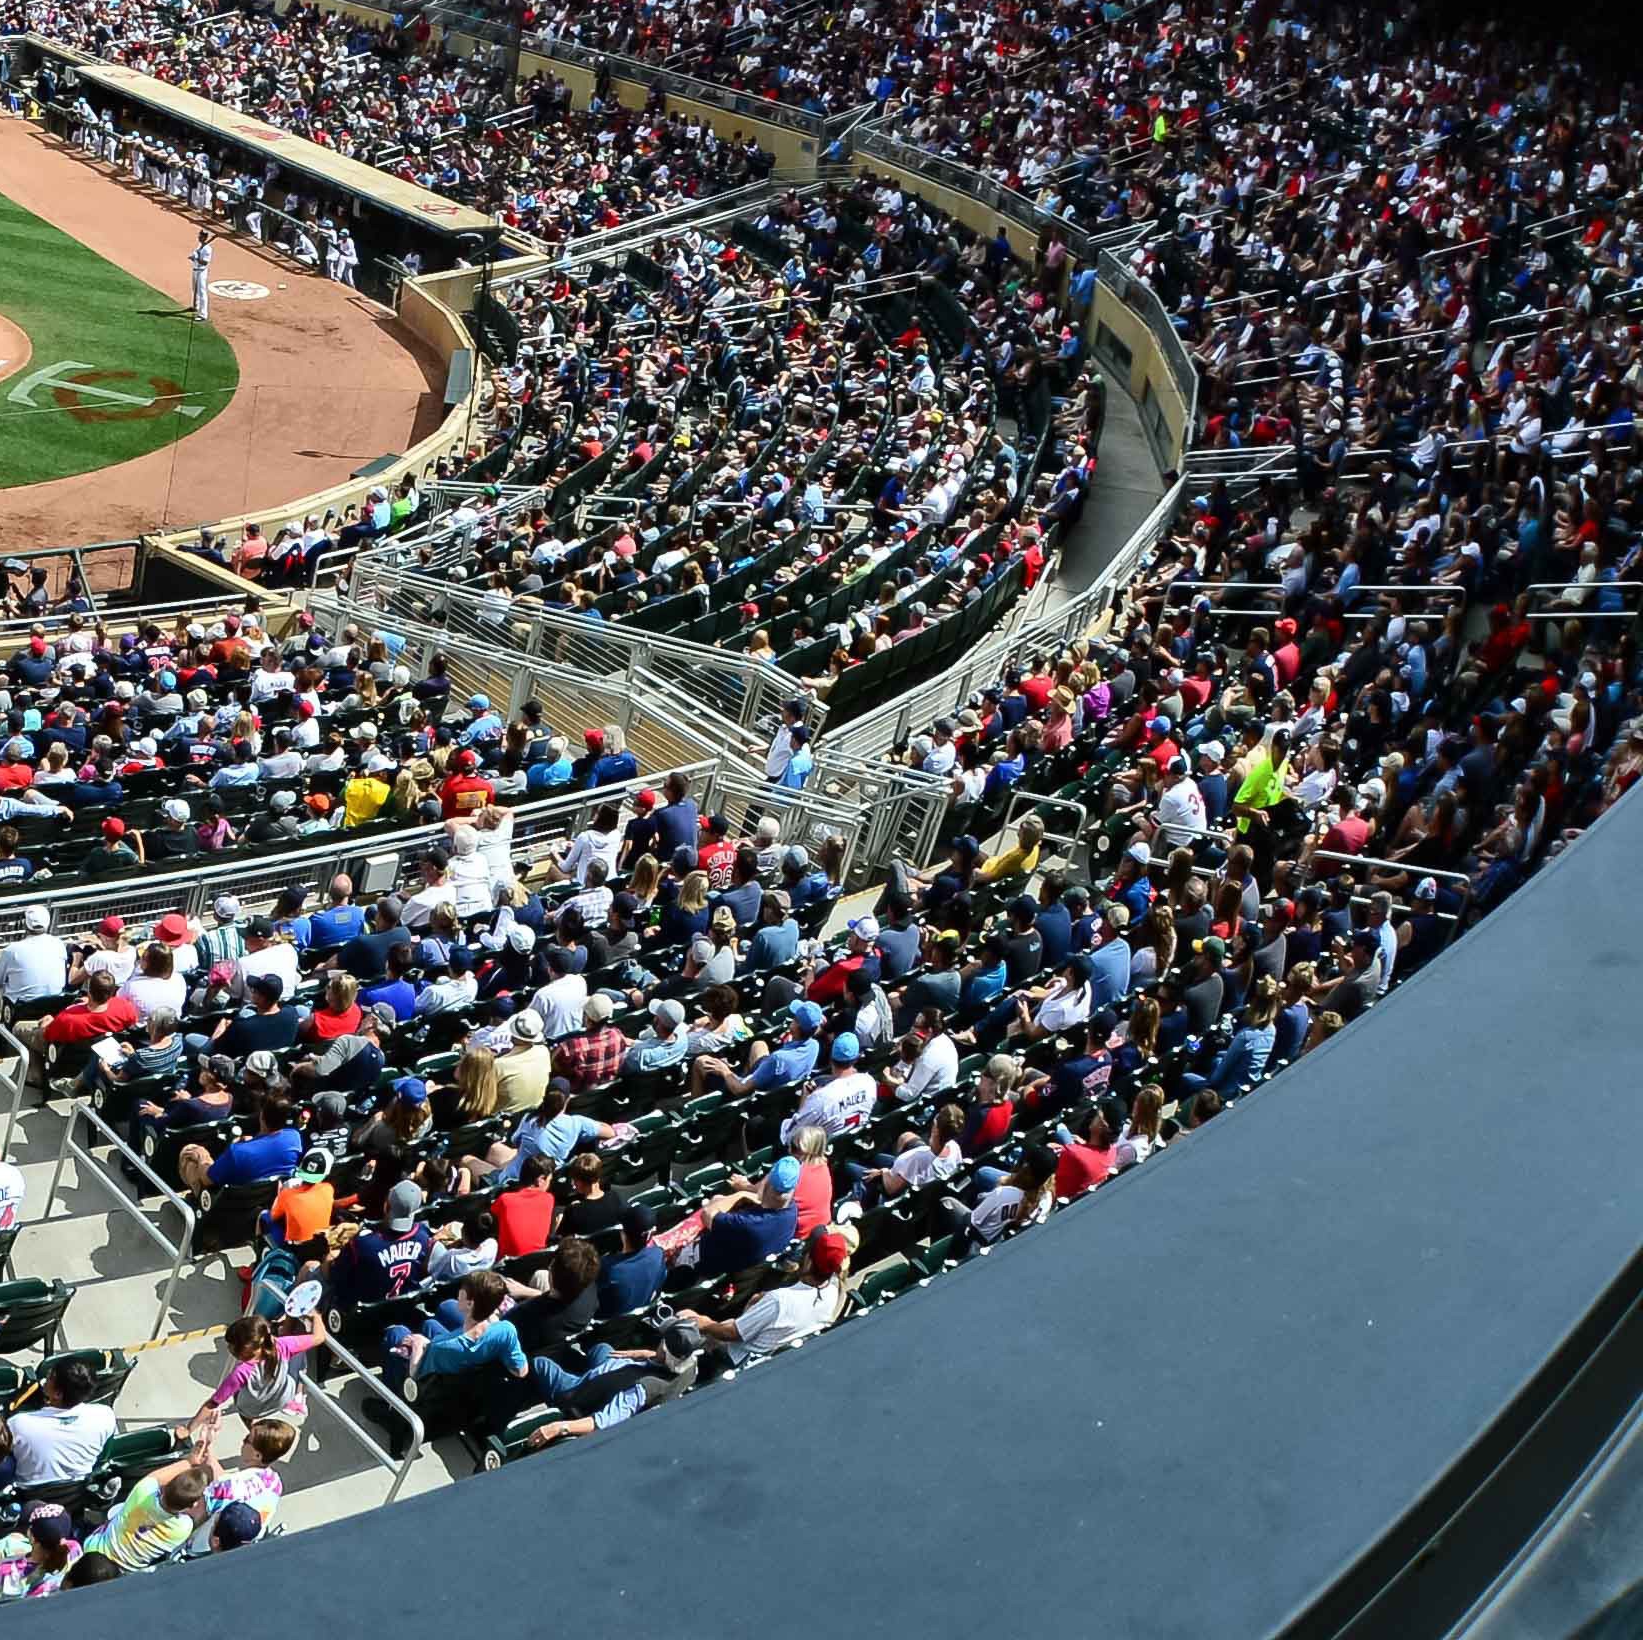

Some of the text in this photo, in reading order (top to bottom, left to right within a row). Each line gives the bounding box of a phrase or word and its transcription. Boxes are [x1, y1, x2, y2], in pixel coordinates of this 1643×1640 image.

[838, 1089, 869, 1114] MAUER
[377, 1241, 423, 1268] MAUER
[385, 1261, 413, 1301] 7
